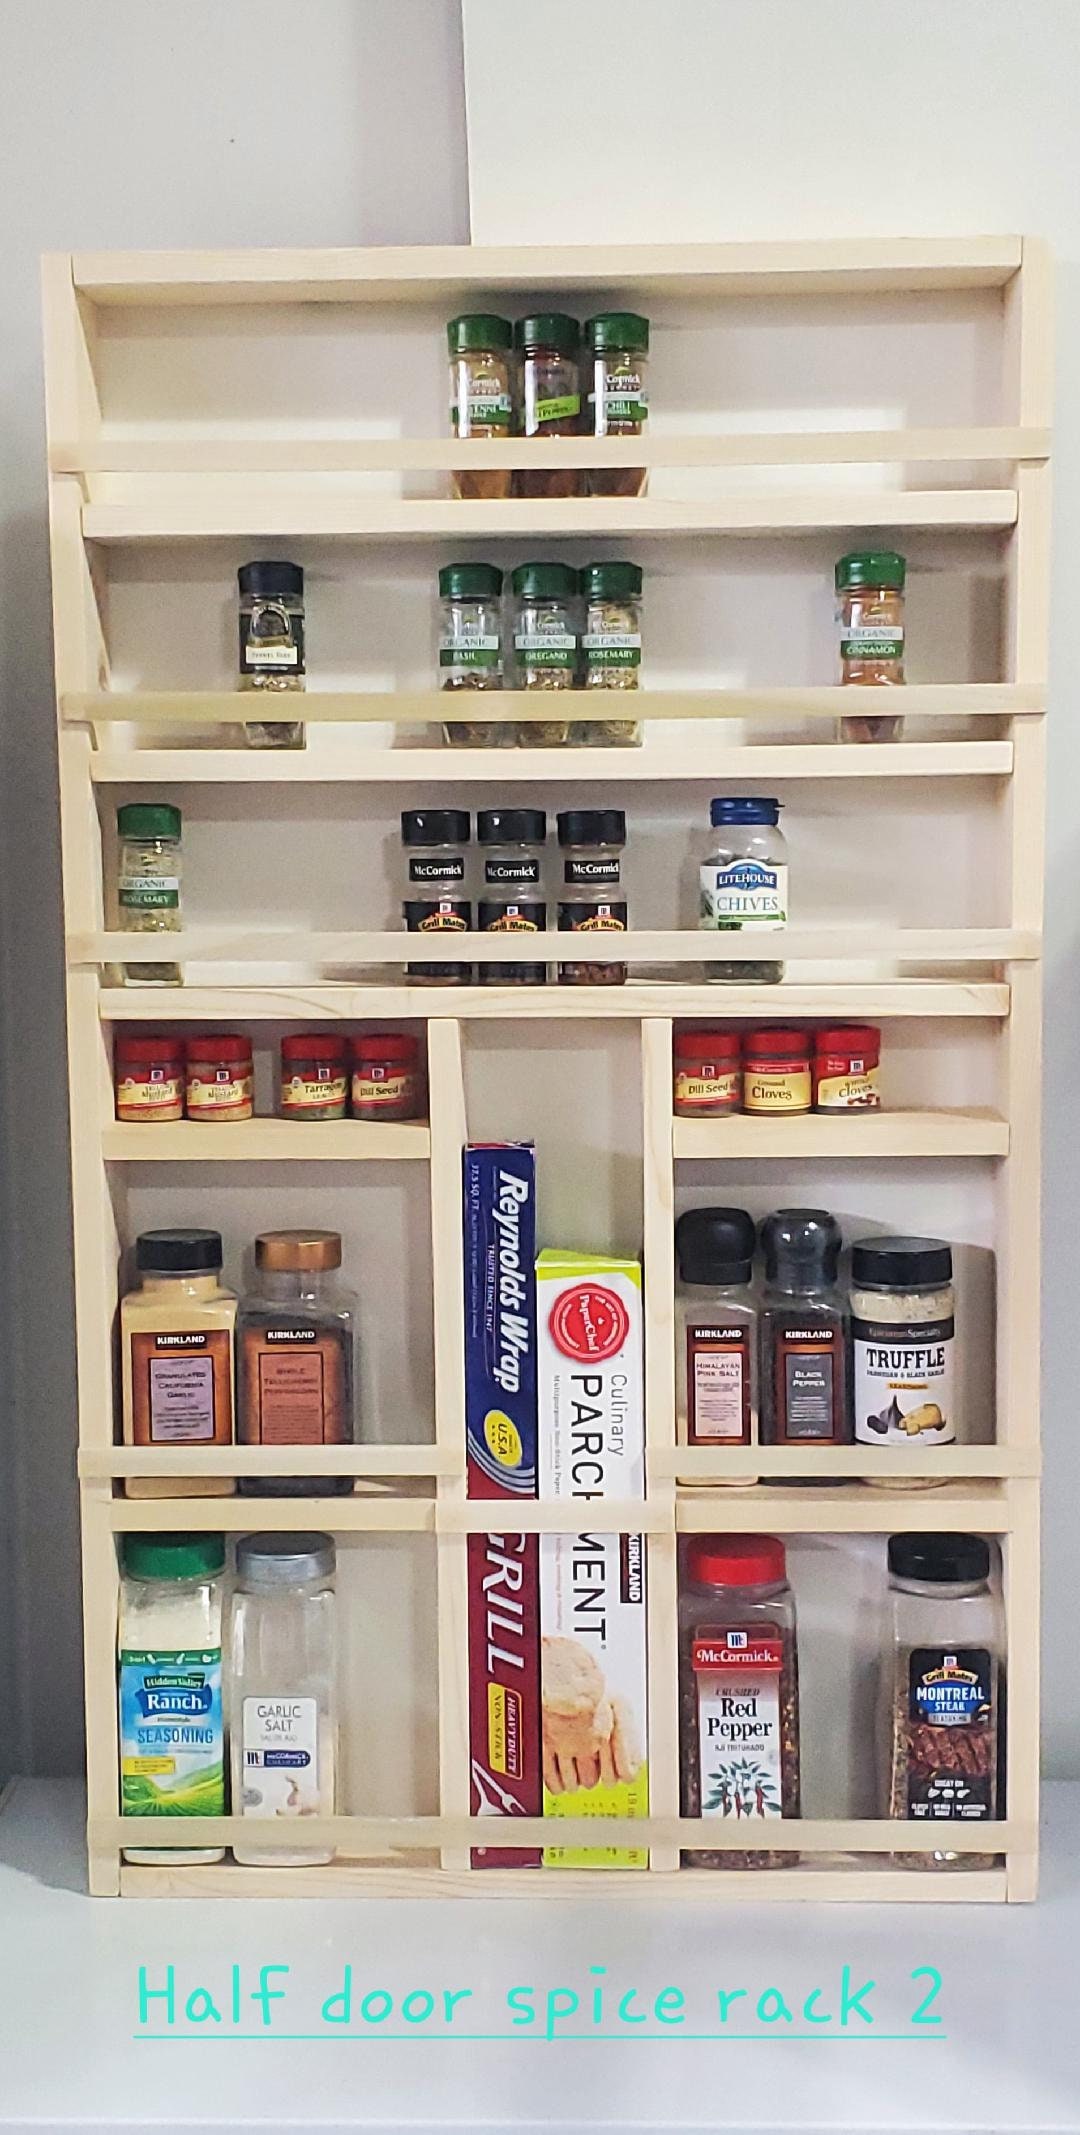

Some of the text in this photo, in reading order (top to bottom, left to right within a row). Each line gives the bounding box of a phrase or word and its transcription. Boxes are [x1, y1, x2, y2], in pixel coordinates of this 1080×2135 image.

[525, 651, 568, 661] OREGANO
[588, 650, 633, 660] ROSEMARY
[846, 646, 896, 655] CINNAMON
[414, 864, 462, 876] McCormick
[487, 866, 536, 877] McCormick
[719, 874, 776, 886] LITEHOUSE
[123, 893, 169, 904] ROSEMARY
[716, 896, 778, 911] CHIVES
[422, 916, 466, 930] Grill Mates
[361, 1085, 399, 1096] Dill Seed
[688, 1082, 728, 1094] Dill Seed
[752, 1087, 792, 1100] Cloves
[838, 1083, 873, 1097] Cloves
[492, 1170, 529, 1393] Reynolds Wrap
[579, 1294, 600, 1352] PaperChef
[267, 1331, 315, 1339] KIRKLAND
[695, 1329, 742, 1338] KIRKLAND
[785, 1331, 833, 1339] KIRKLAND
[156, 1335, 205, 1345] KIRKLAND
[866, 1347, 945, 1369] TRUFFLE
[609, 1374, 628, 1456] Culinary
[697, 1649, 774, 1663] McCormick
[926, 1670, 973, 1682] Grill Mates
[146, 1677, 202, 1688] Hidden Valley
[916, 1686, 985, 1701] MONTREAL
[147, 1694, 203, 1710] Ranch
[720, 1698, 757, 1718] Red
[934, 1701, 966, 1711] STEAK
[257, 1705, 302, 1718] GARLIC
[265, 1719, 294, 1732] SALT
[707, 1718, 773, 1741] Pepper
[137, 1727, 214, 1744] SEASONING
